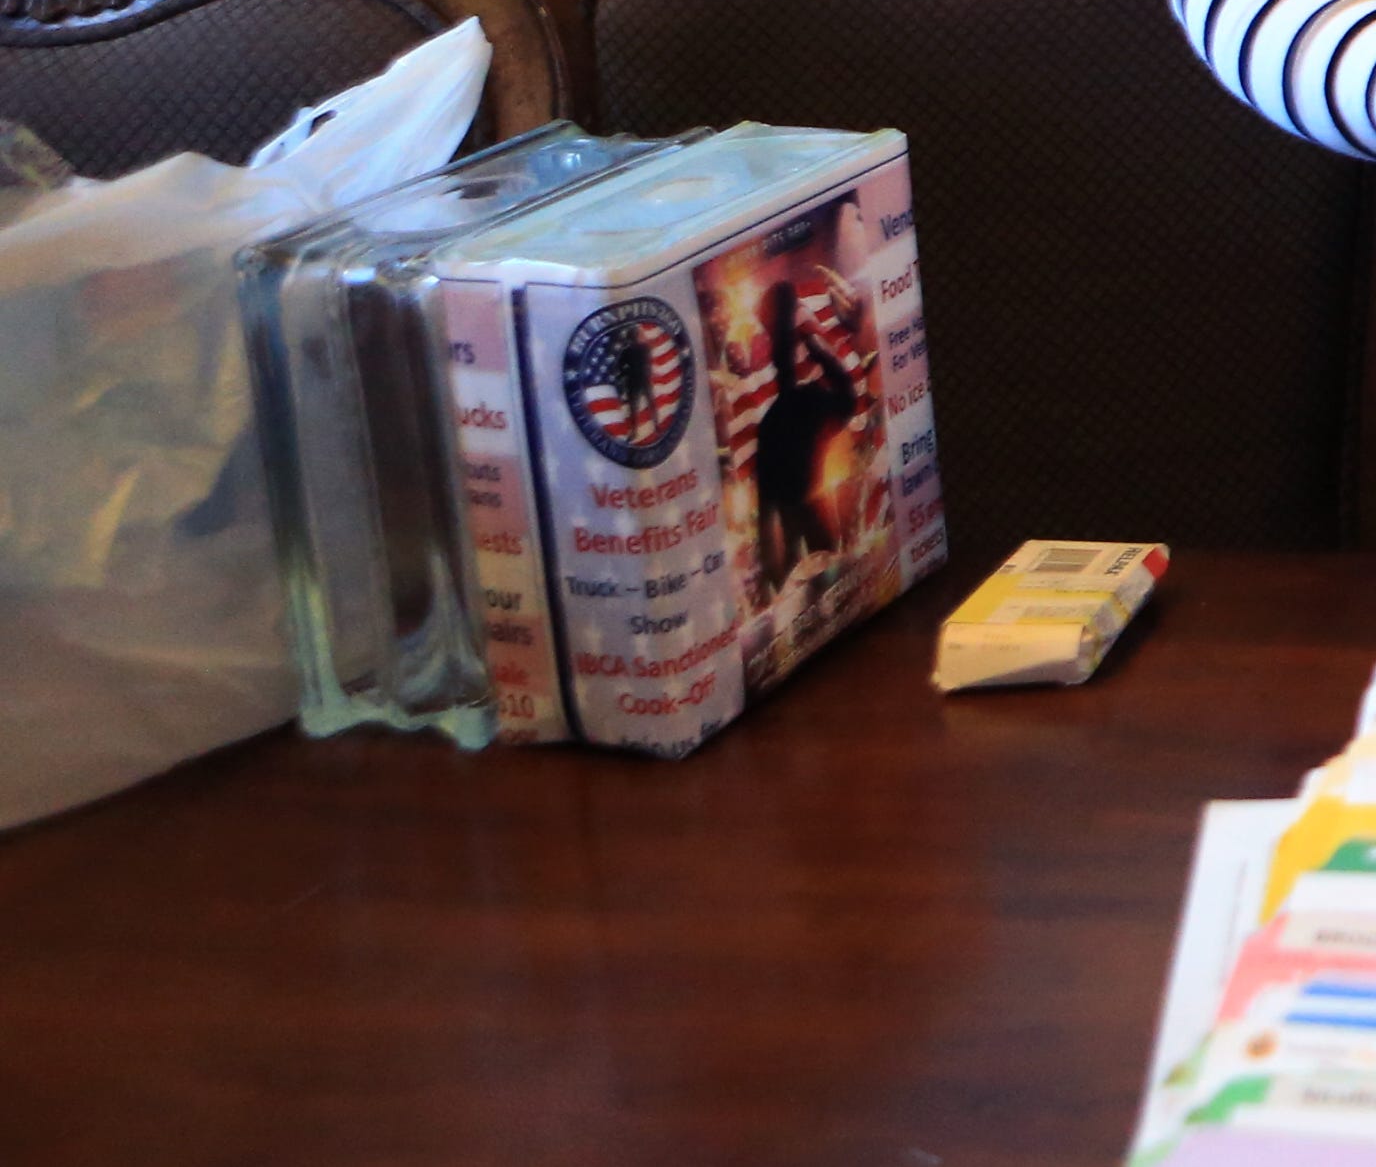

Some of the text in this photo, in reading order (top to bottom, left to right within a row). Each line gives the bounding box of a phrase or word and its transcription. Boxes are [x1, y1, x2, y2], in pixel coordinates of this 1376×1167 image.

[587, 468, 698, 509] Veterans
[573, 500, 719, 554] Benefits Fair
[564, 575, 620, 597] Truck
[645, 572, 687, 599] Bike
[629, 610, 688, 634] Show
[631, 606, 745, 677] Sanctioned
